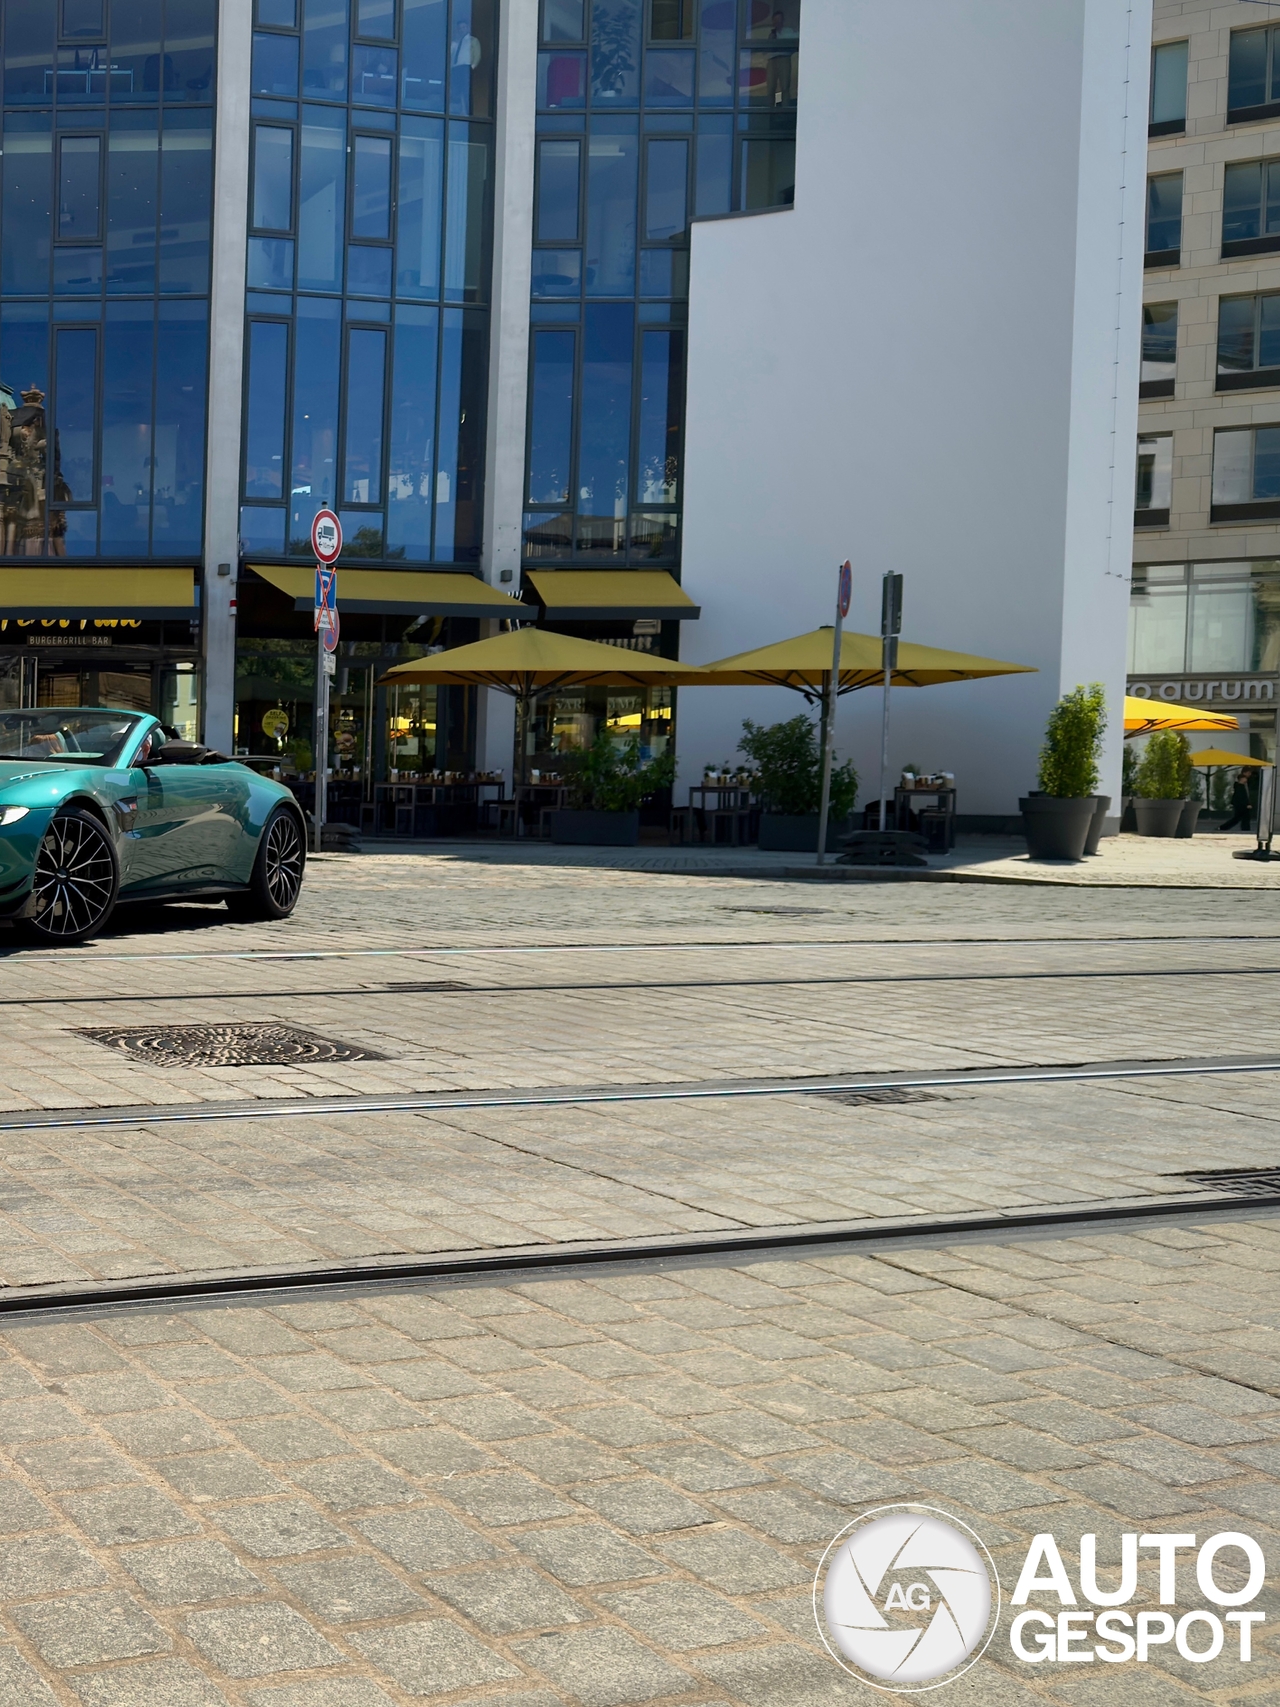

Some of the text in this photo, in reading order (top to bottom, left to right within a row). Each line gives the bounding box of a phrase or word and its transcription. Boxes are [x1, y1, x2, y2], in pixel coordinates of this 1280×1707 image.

[29, 635, 109, 645] BURGERGRILL BAR
[1159, 680, 1274, 700] aurum
